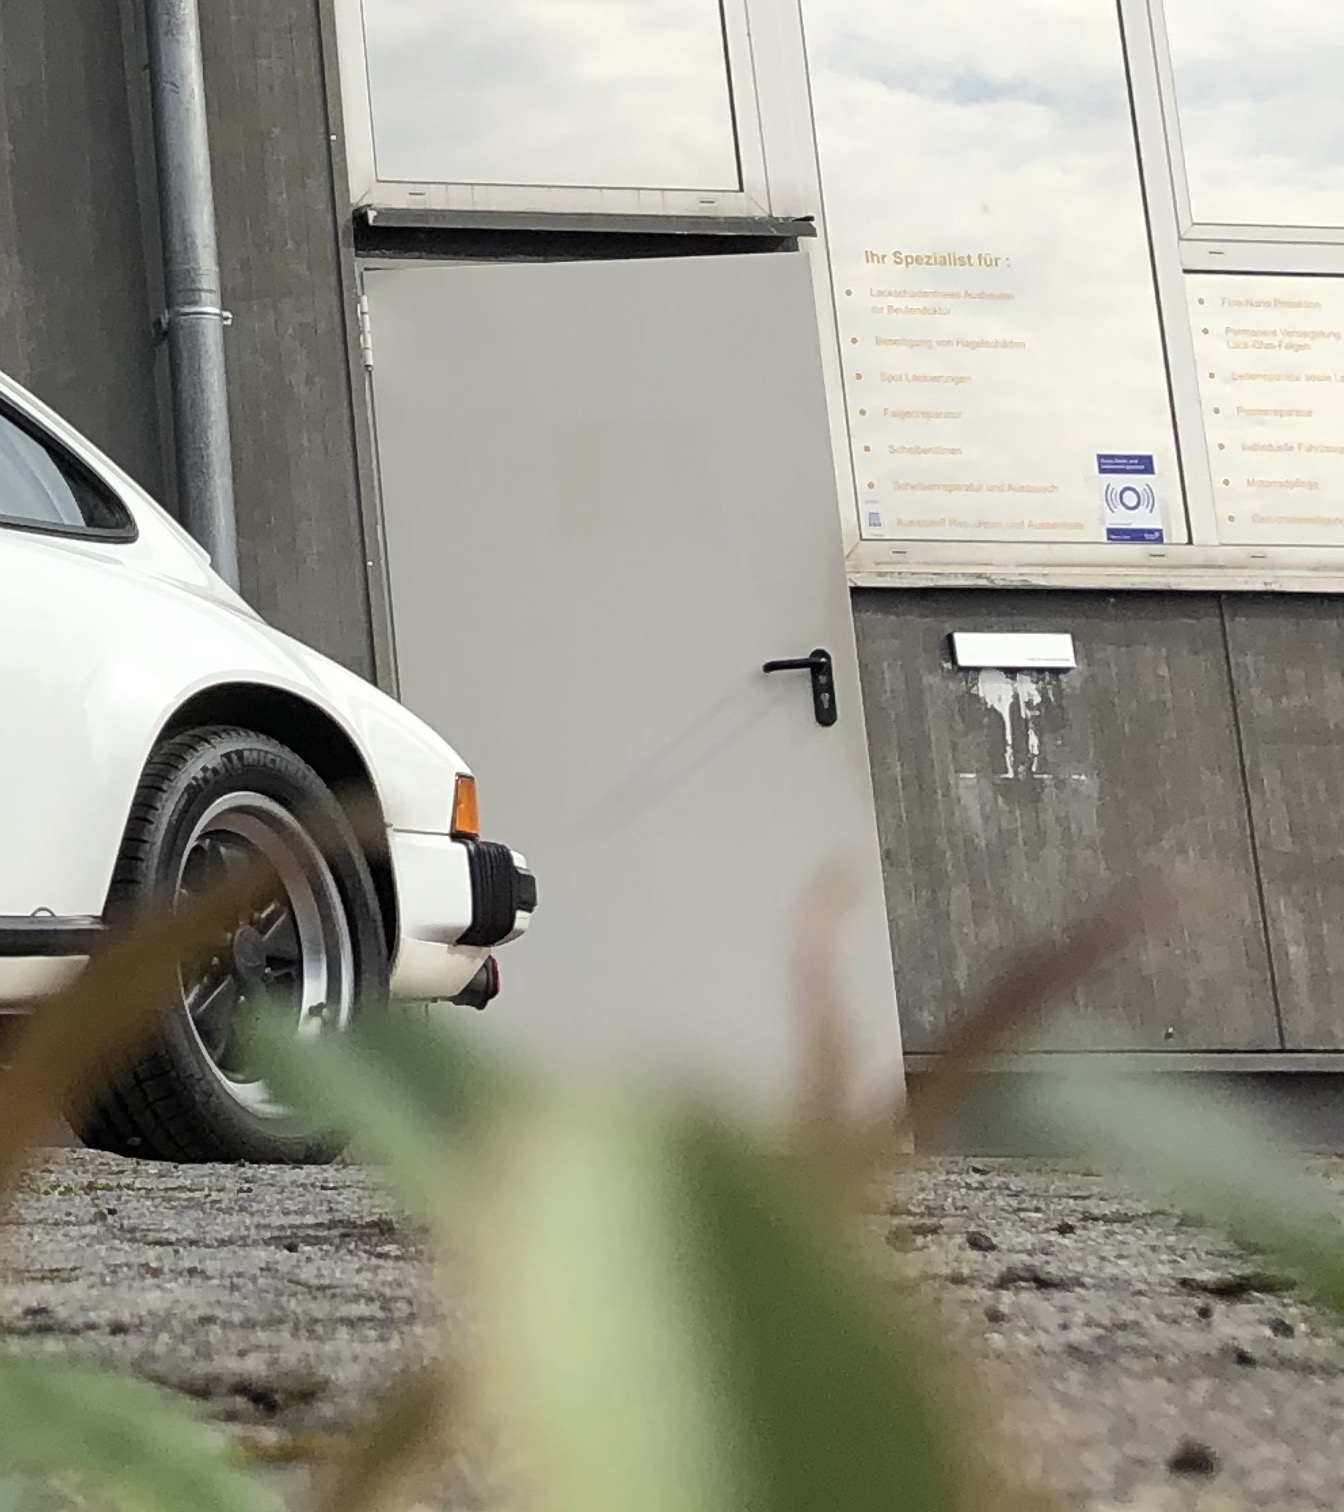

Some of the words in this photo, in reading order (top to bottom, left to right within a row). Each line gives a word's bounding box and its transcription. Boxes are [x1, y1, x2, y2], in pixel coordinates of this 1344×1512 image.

[865, 250, 887, 264] Ihr
[892, 250, 974, 268] Spezialist
[978, 253, 1001, 268] für
